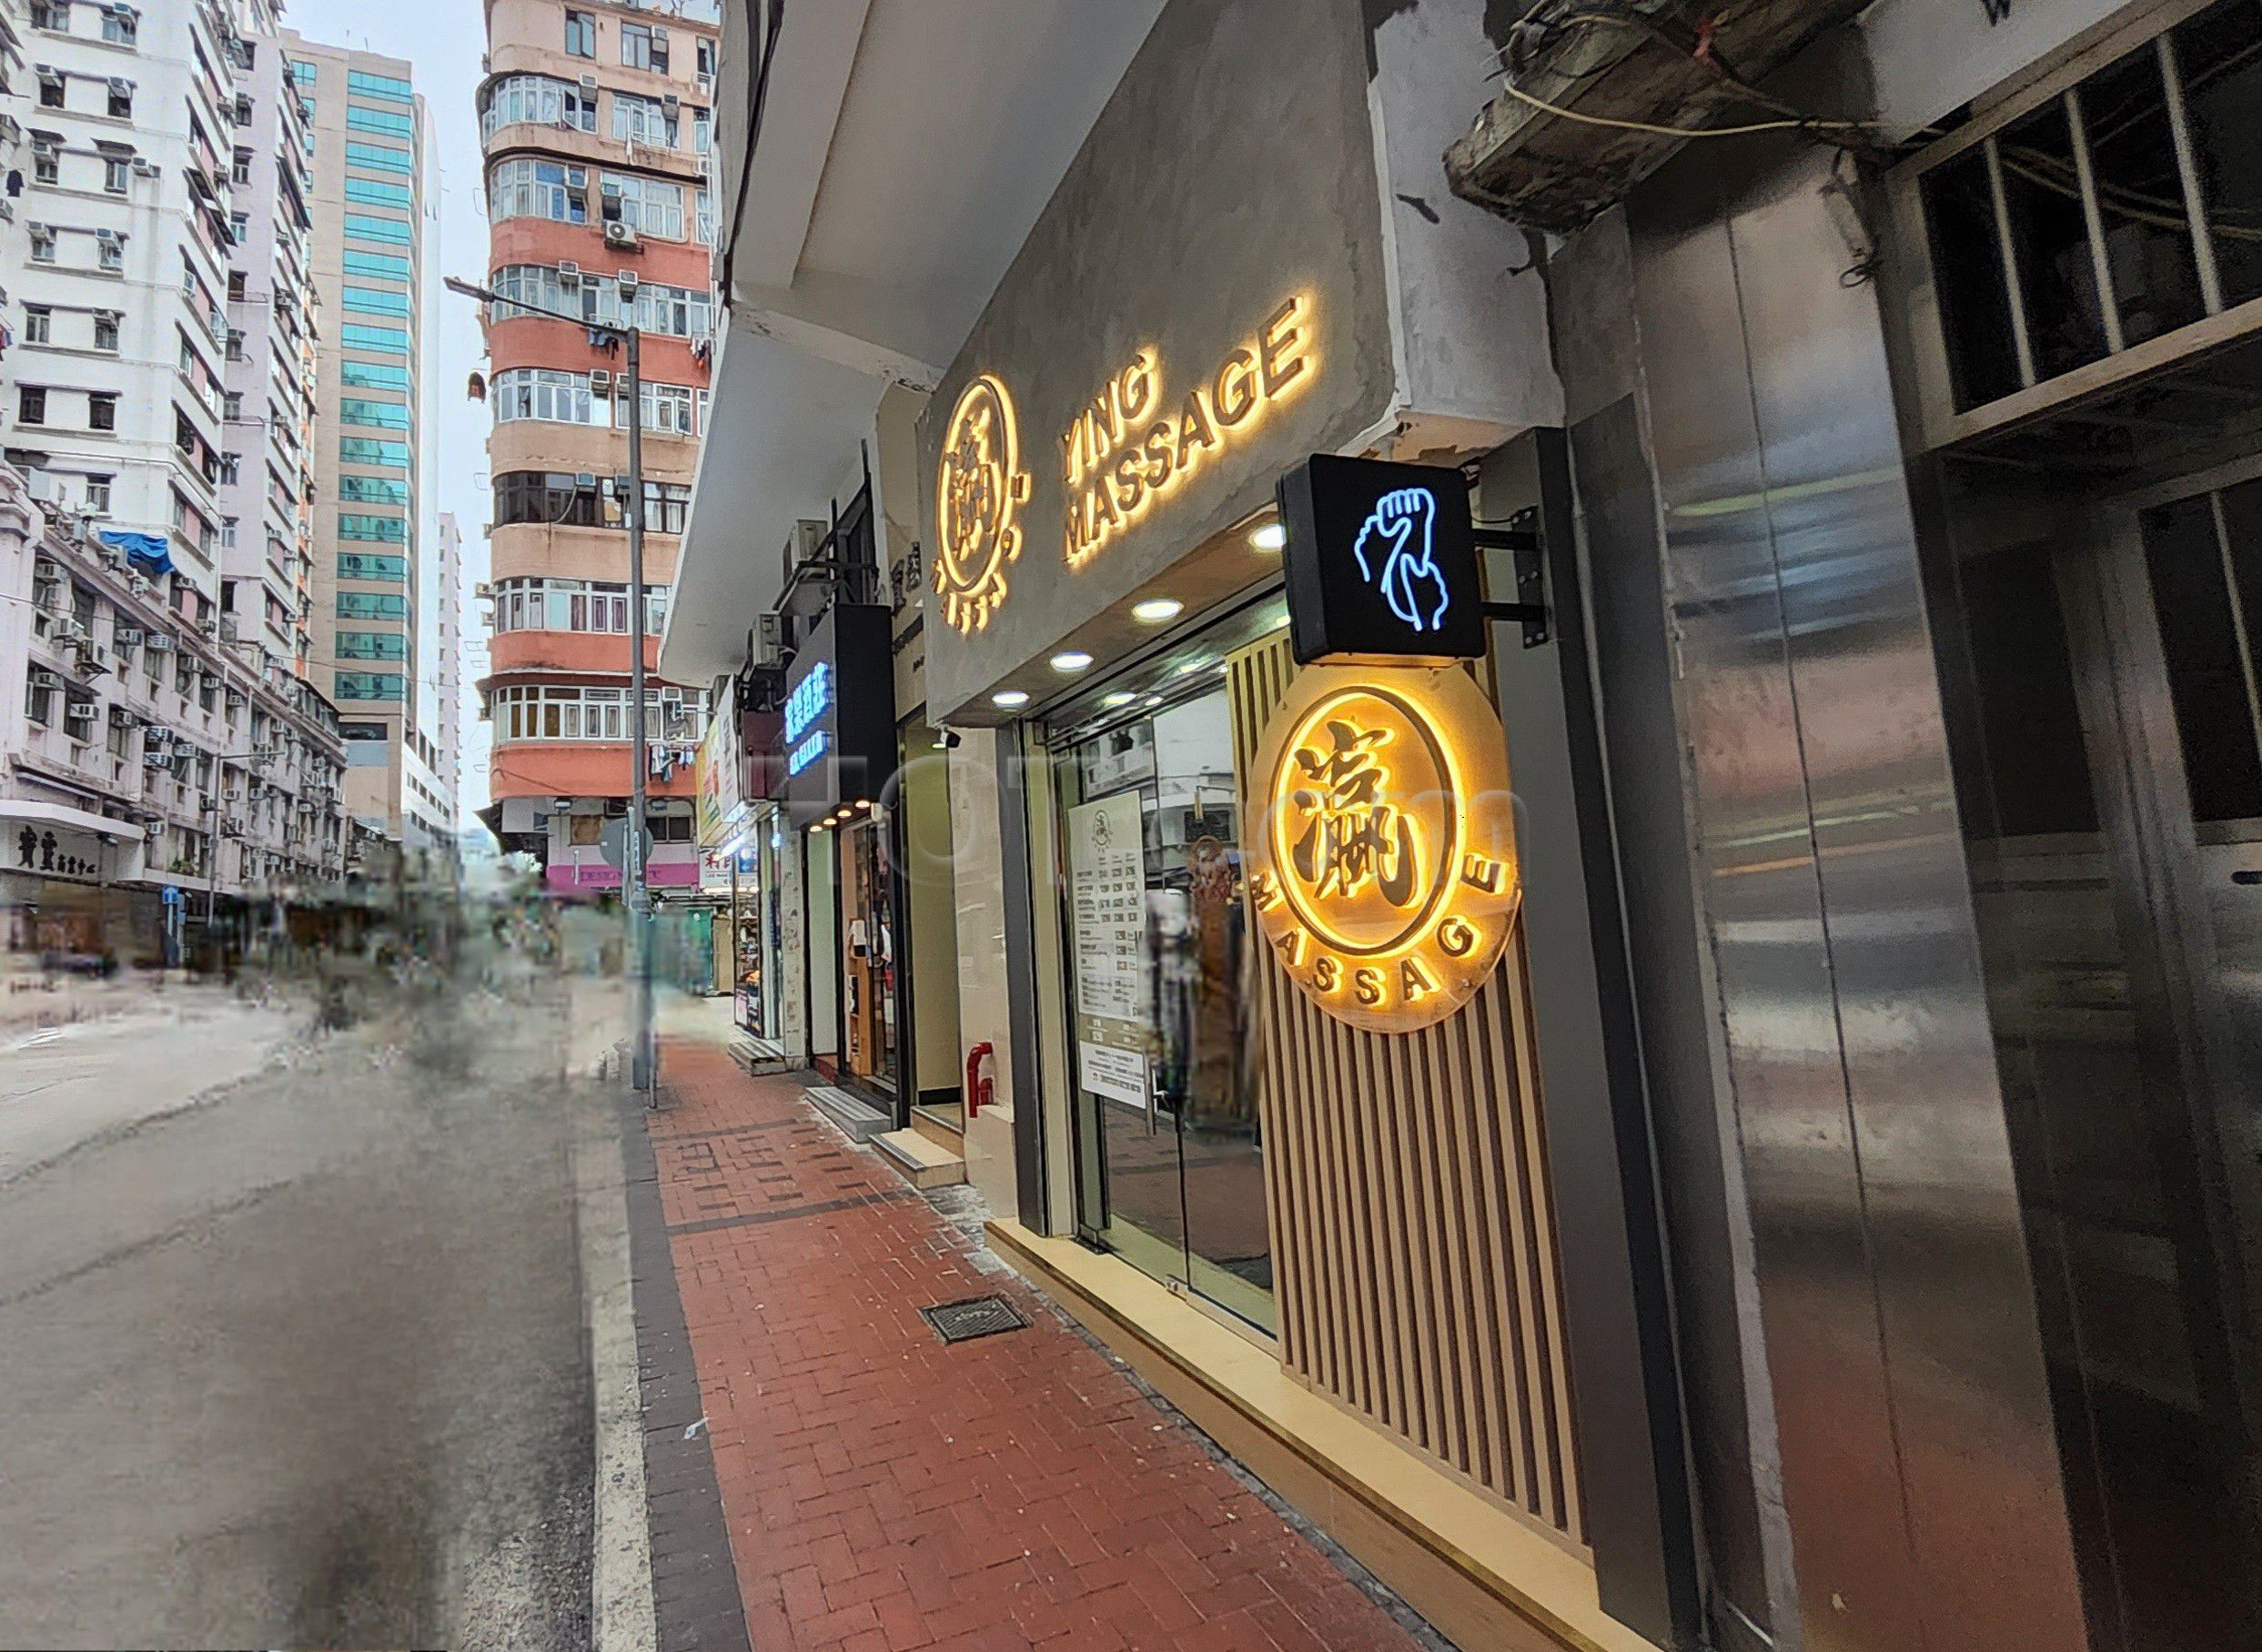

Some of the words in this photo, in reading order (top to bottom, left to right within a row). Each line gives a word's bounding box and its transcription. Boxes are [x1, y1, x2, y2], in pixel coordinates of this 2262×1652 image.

[1062, 353, 1156, 483] YING
[1065, 296, 1310, 564] MASSAGE
[1249, 852, 1509, 1006] MASSAGE
